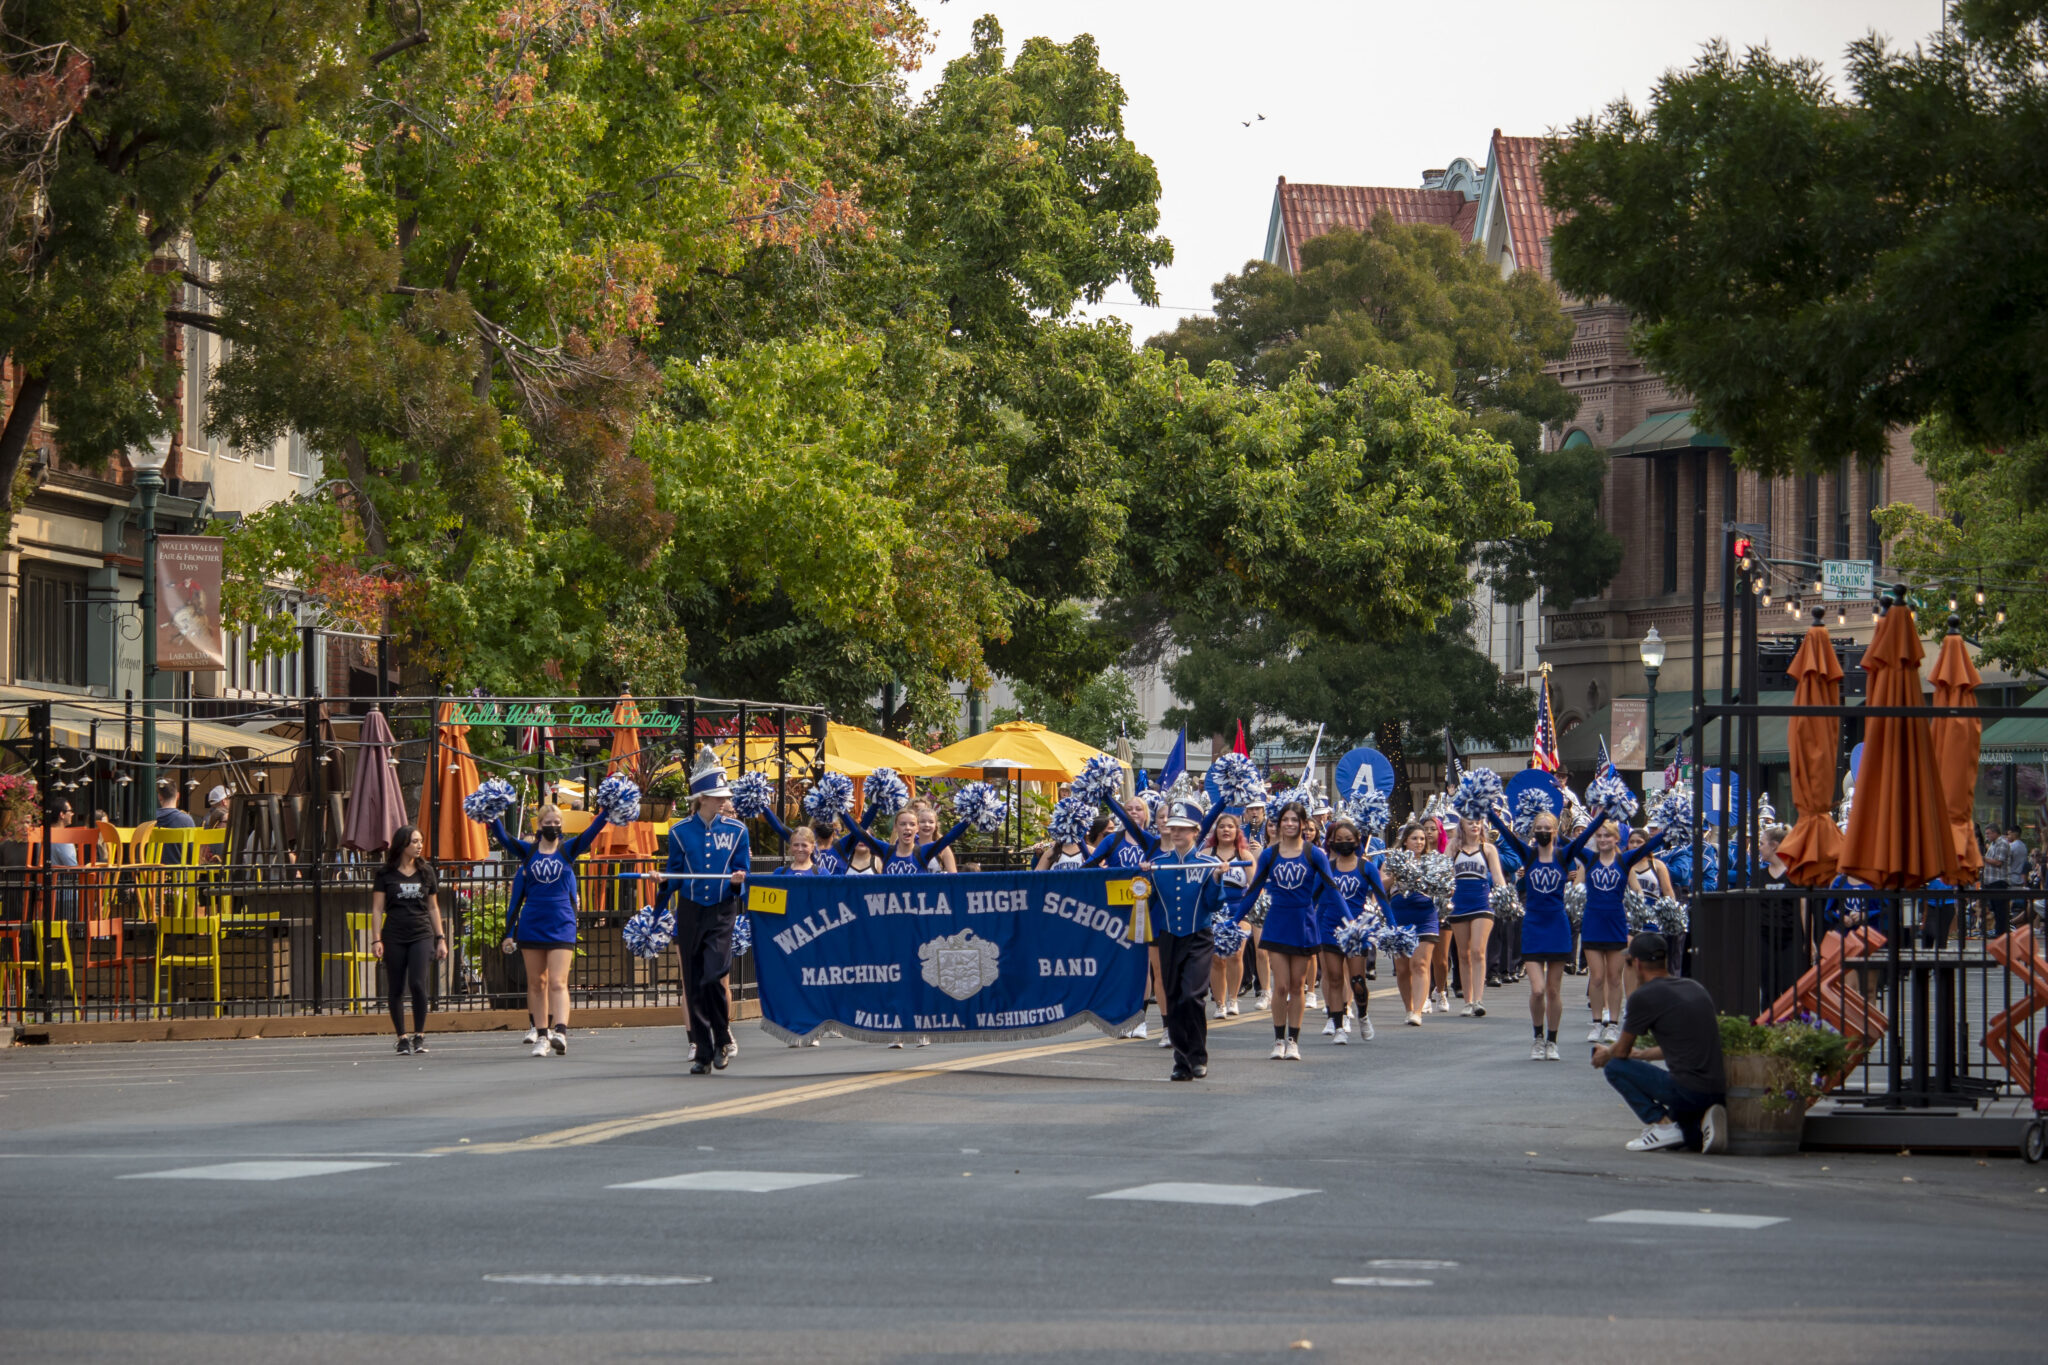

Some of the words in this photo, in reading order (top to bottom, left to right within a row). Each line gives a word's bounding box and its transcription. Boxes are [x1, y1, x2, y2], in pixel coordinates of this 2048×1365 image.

[162, 543, 188, 551] WALLA
[191, 544, 219, 552] WALLA
[160, 552, 176, 560] FAIR
[184, 553, 220, 562] FRONTIER
[179, 563, 199, 571] DAYS
[1825, 563, 1843, 574] TWO
[1847, 563, 1870, 575] HOUR
[1830, 575, 1865, 586] PARKING
[1836, 587, 1859, 598] ZONE
[450, 703, 501, 725] Walla
[505, 704, 557, 726] Walla
[569, 705, 616, 726] Pasta
[623, 705, 681, 734] Factory
[1352, 763, 1375, 794] A
[760, 891, 777, 904] 10
[1119, 888, 1133, 901] 10
[772, 902, 857, 955] WALLA
[863, 892, 951, 916] WALLA
[967, 890, 1028, 914] HIGH
[1042, 892, 1133, 950] SCHOOL
[802, 964, 901, 986] MARCHING
[1038, 957, 1097, 977] BAND
[854, 1010, 901, 1029] WALLA
[976, 1003, 1065, 1028] WASHINGTON
